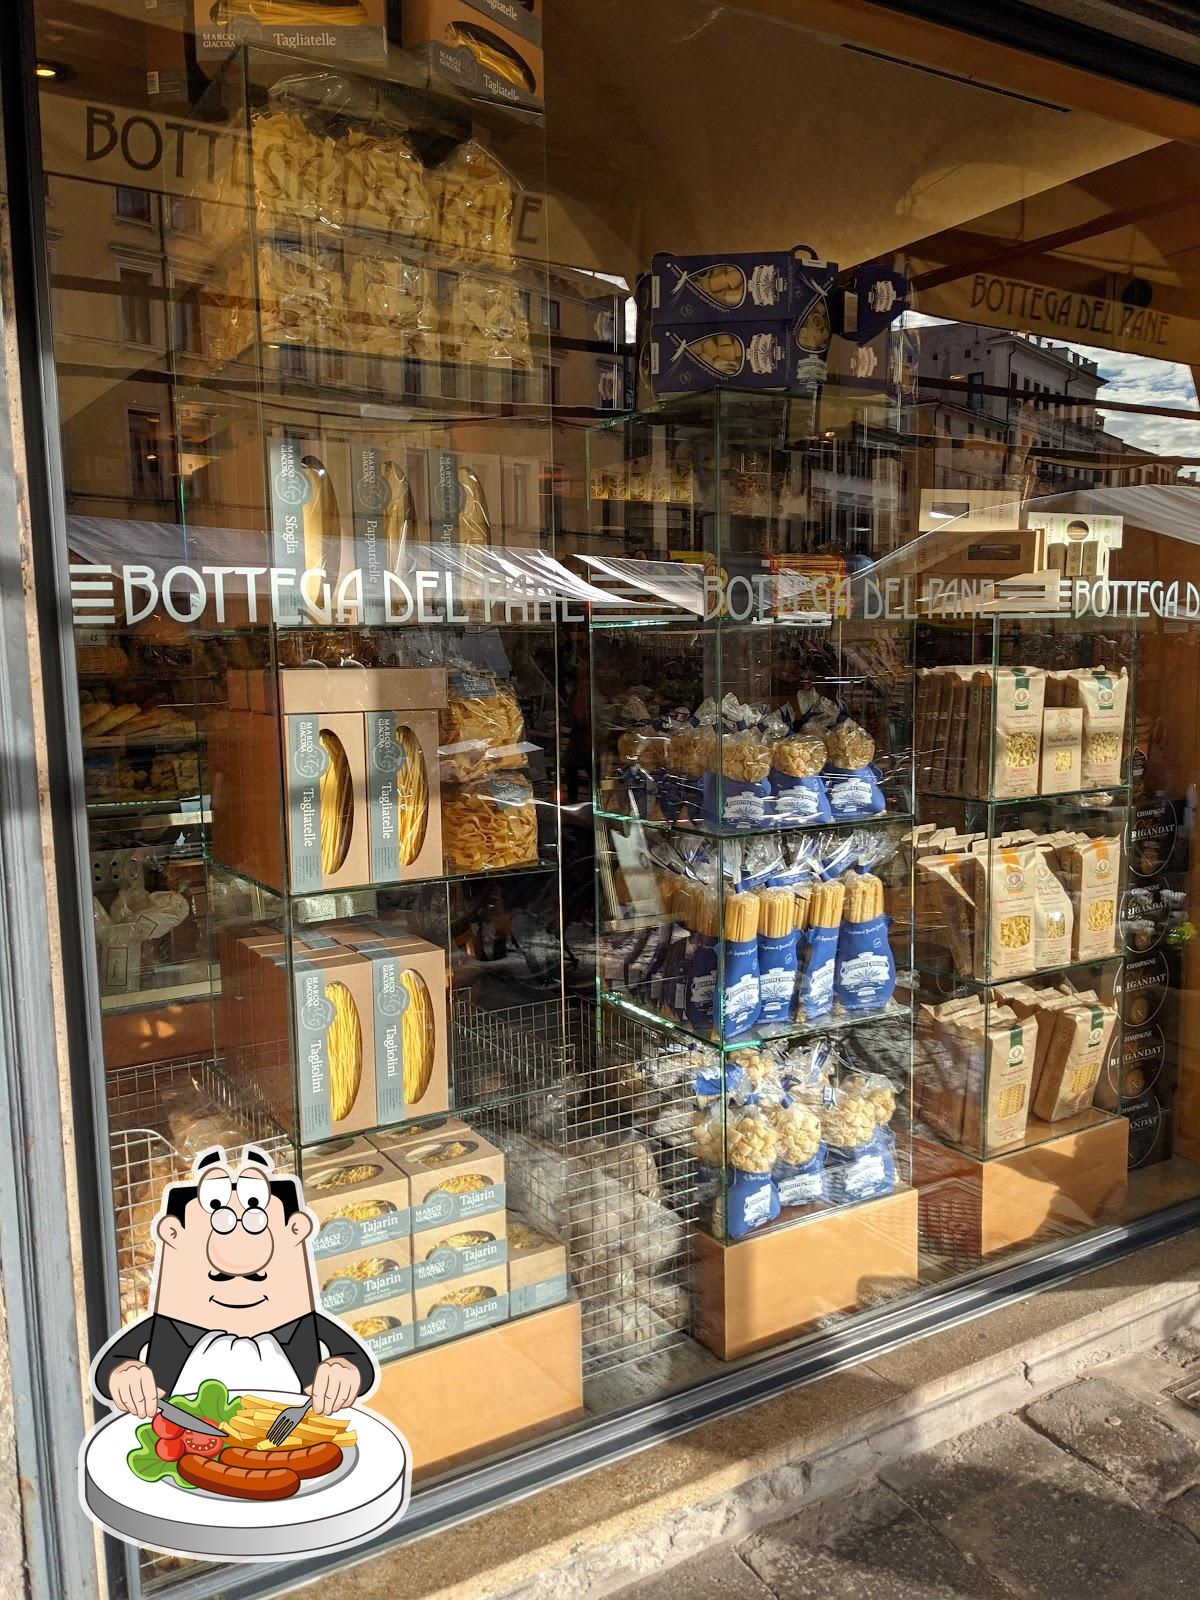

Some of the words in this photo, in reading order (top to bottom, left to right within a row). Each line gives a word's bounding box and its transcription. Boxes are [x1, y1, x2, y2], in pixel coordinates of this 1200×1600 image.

[203, 33, 235, 41] MARCO
[203, 40, 236, 48] GIACOSA
[273, 33, 337, 49] Tagliatelle
[484, 74, 519, 101] Tagliatelle
[971, 274, 1073, 326] BOTTEGA
[1077, 297, 1111, 336] DEL
[283, 515, 298, 554] Sfoglia
[123, 566, 363, 626] BOTTEGA
[384, 568, 469, 624] DEL
[864, 578, 918, 620] DEL
[927, 578, 994, 619] PANE
[1074, 580, 1178, 619] BOTTEGA
[305, 721, 313, 753] MARCO
[300, 787, 316, 847] Tagliatelle
[379, 782, 394, 840] Tagliatelle
[1130, 823, 1176, 839] RIGANDAT
[1115, 973, 1167, 993] BIGANDAT
[384, 1025, 398, 1077] Tagliolini
[308, 1039, 324, 1094] Tagliolini
[460, 1189, 495, 1206] Tajarin
[415, 1204, 442, 1217] MARCO
[361, 1214, 399, 1233] Tajarin
[462, 1244, 498, 1262] Tajarin
[418, 1261, 445, 1274] MARCO
[364, 1273, 402, 1292] Tajarin
[322, 1291, 344, 1303] ARCO
[463, 1300, 498, 1318] Tajarin
[419, 1319, 446, 1331] MARCO
[367, 1331, 403, 1351] Tajarin
